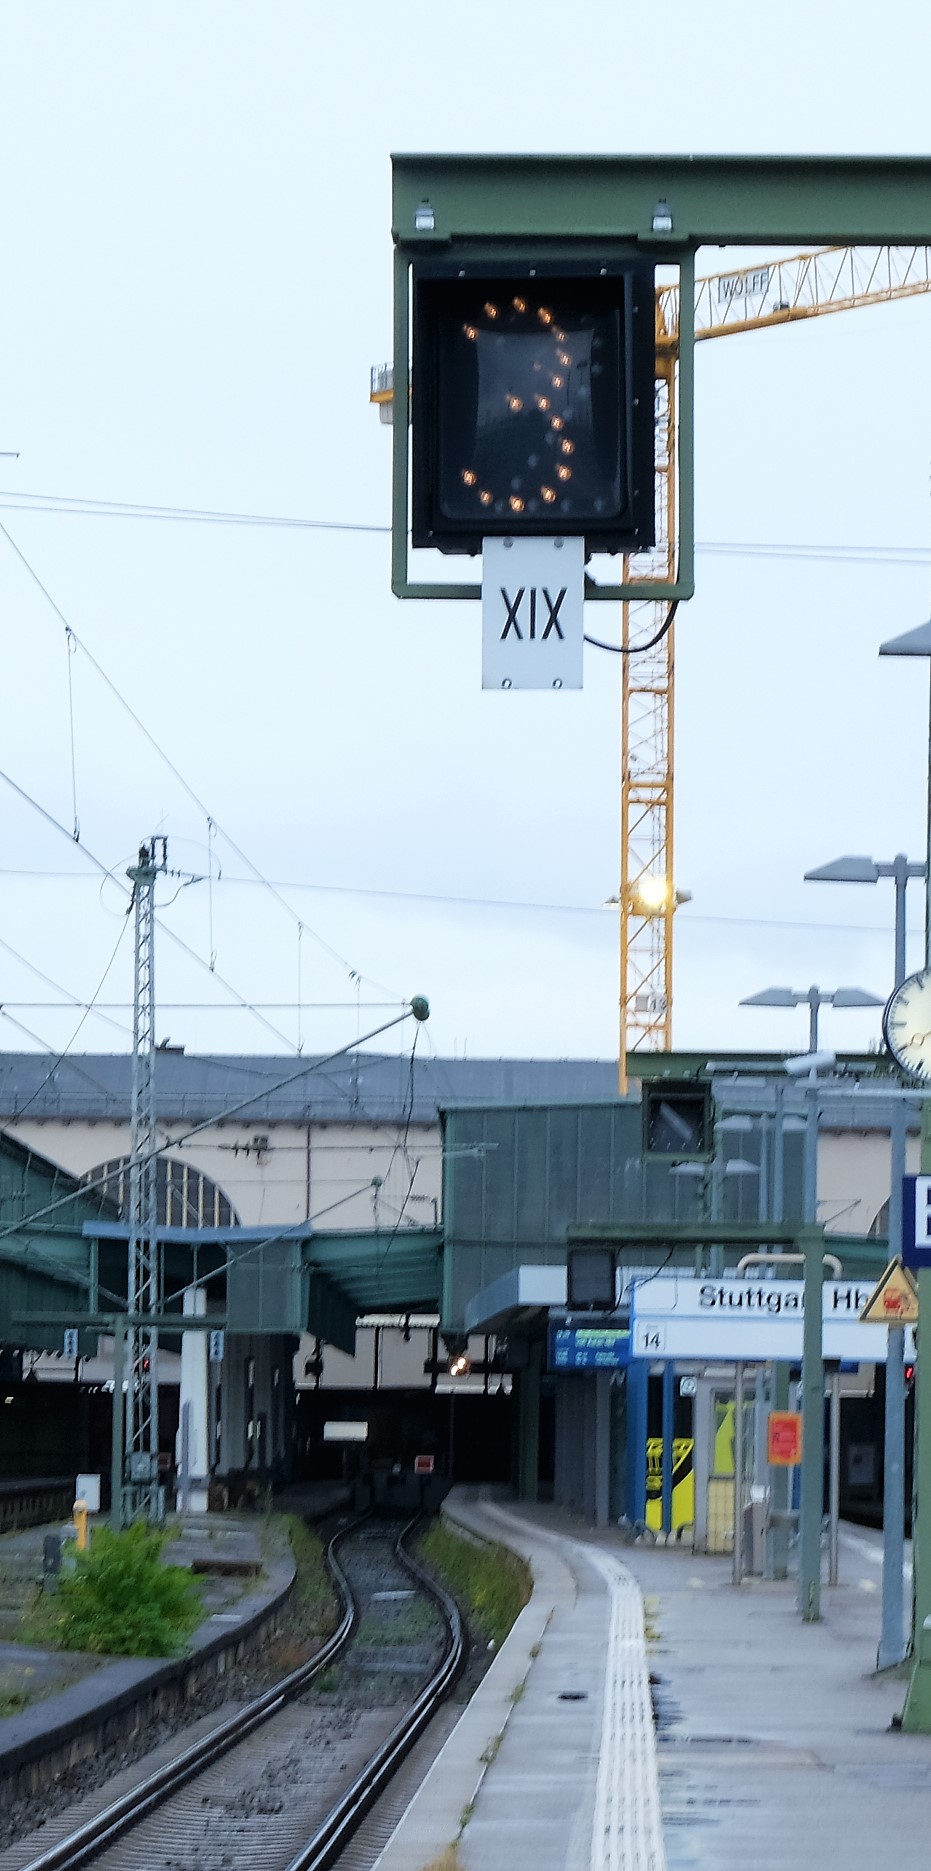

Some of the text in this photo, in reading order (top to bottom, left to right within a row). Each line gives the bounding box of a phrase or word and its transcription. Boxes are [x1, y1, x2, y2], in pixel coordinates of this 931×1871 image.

[723, 271, 768, 298] WOLFF
[463, 296, 575, 512] 3
[500, 587, 567, 640] XIX
[699, 1285, 868, 1313] Stuttga Hb
[645, 1332, 660, 1350] 14
